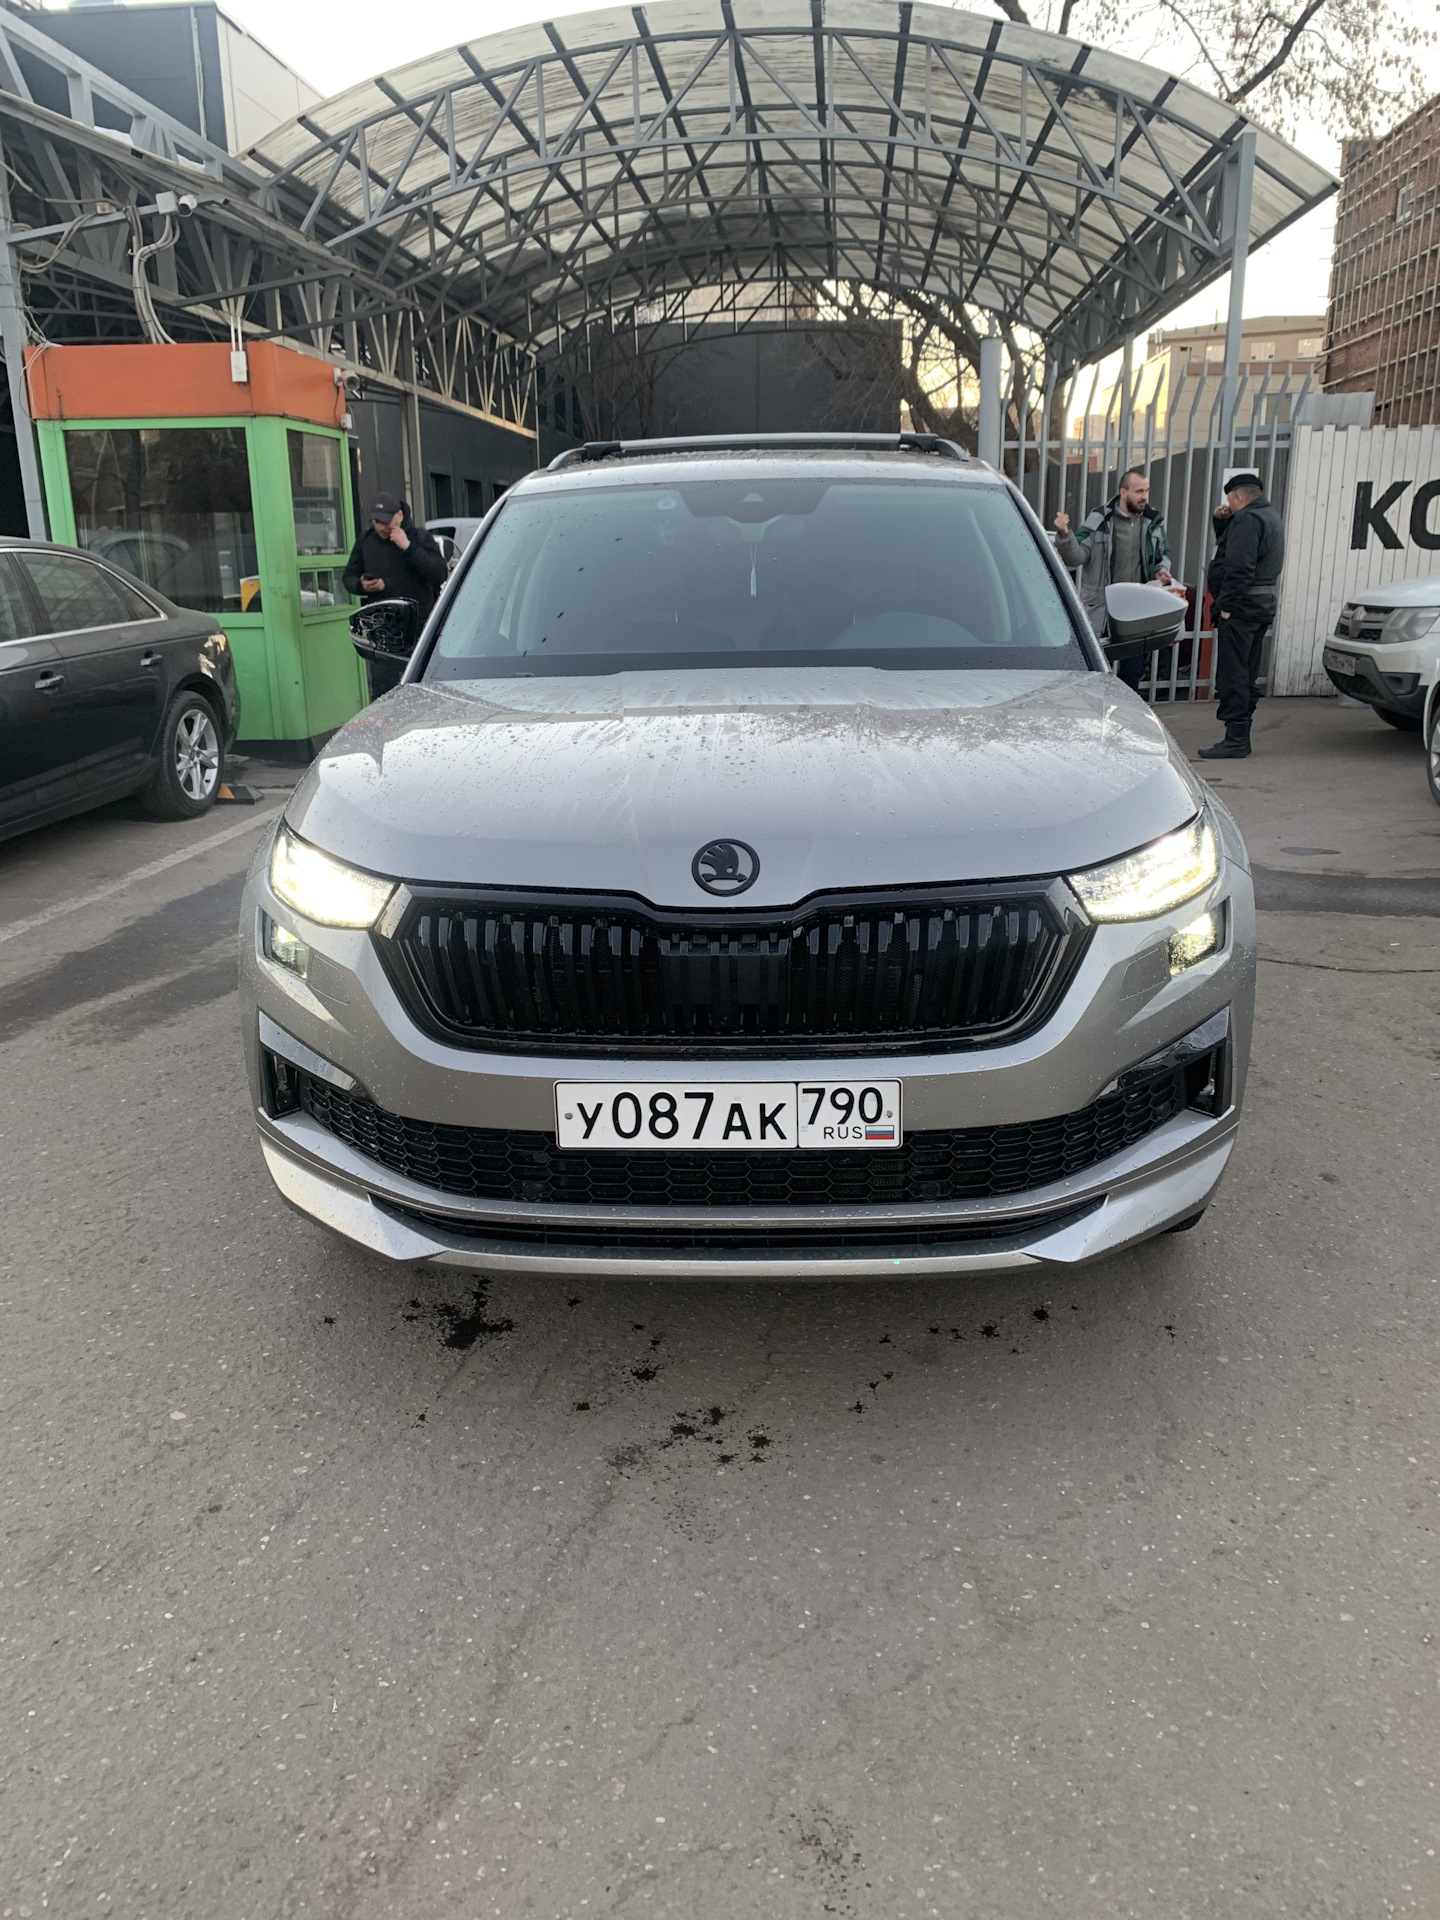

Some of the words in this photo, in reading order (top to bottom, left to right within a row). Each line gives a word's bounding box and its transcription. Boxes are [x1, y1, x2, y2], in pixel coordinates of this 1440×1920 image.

[576, 1091, 786, 1140] У087АК
[802, 1086, 884, 1125] 790
[823, 1126, 864, 1140] RUS
